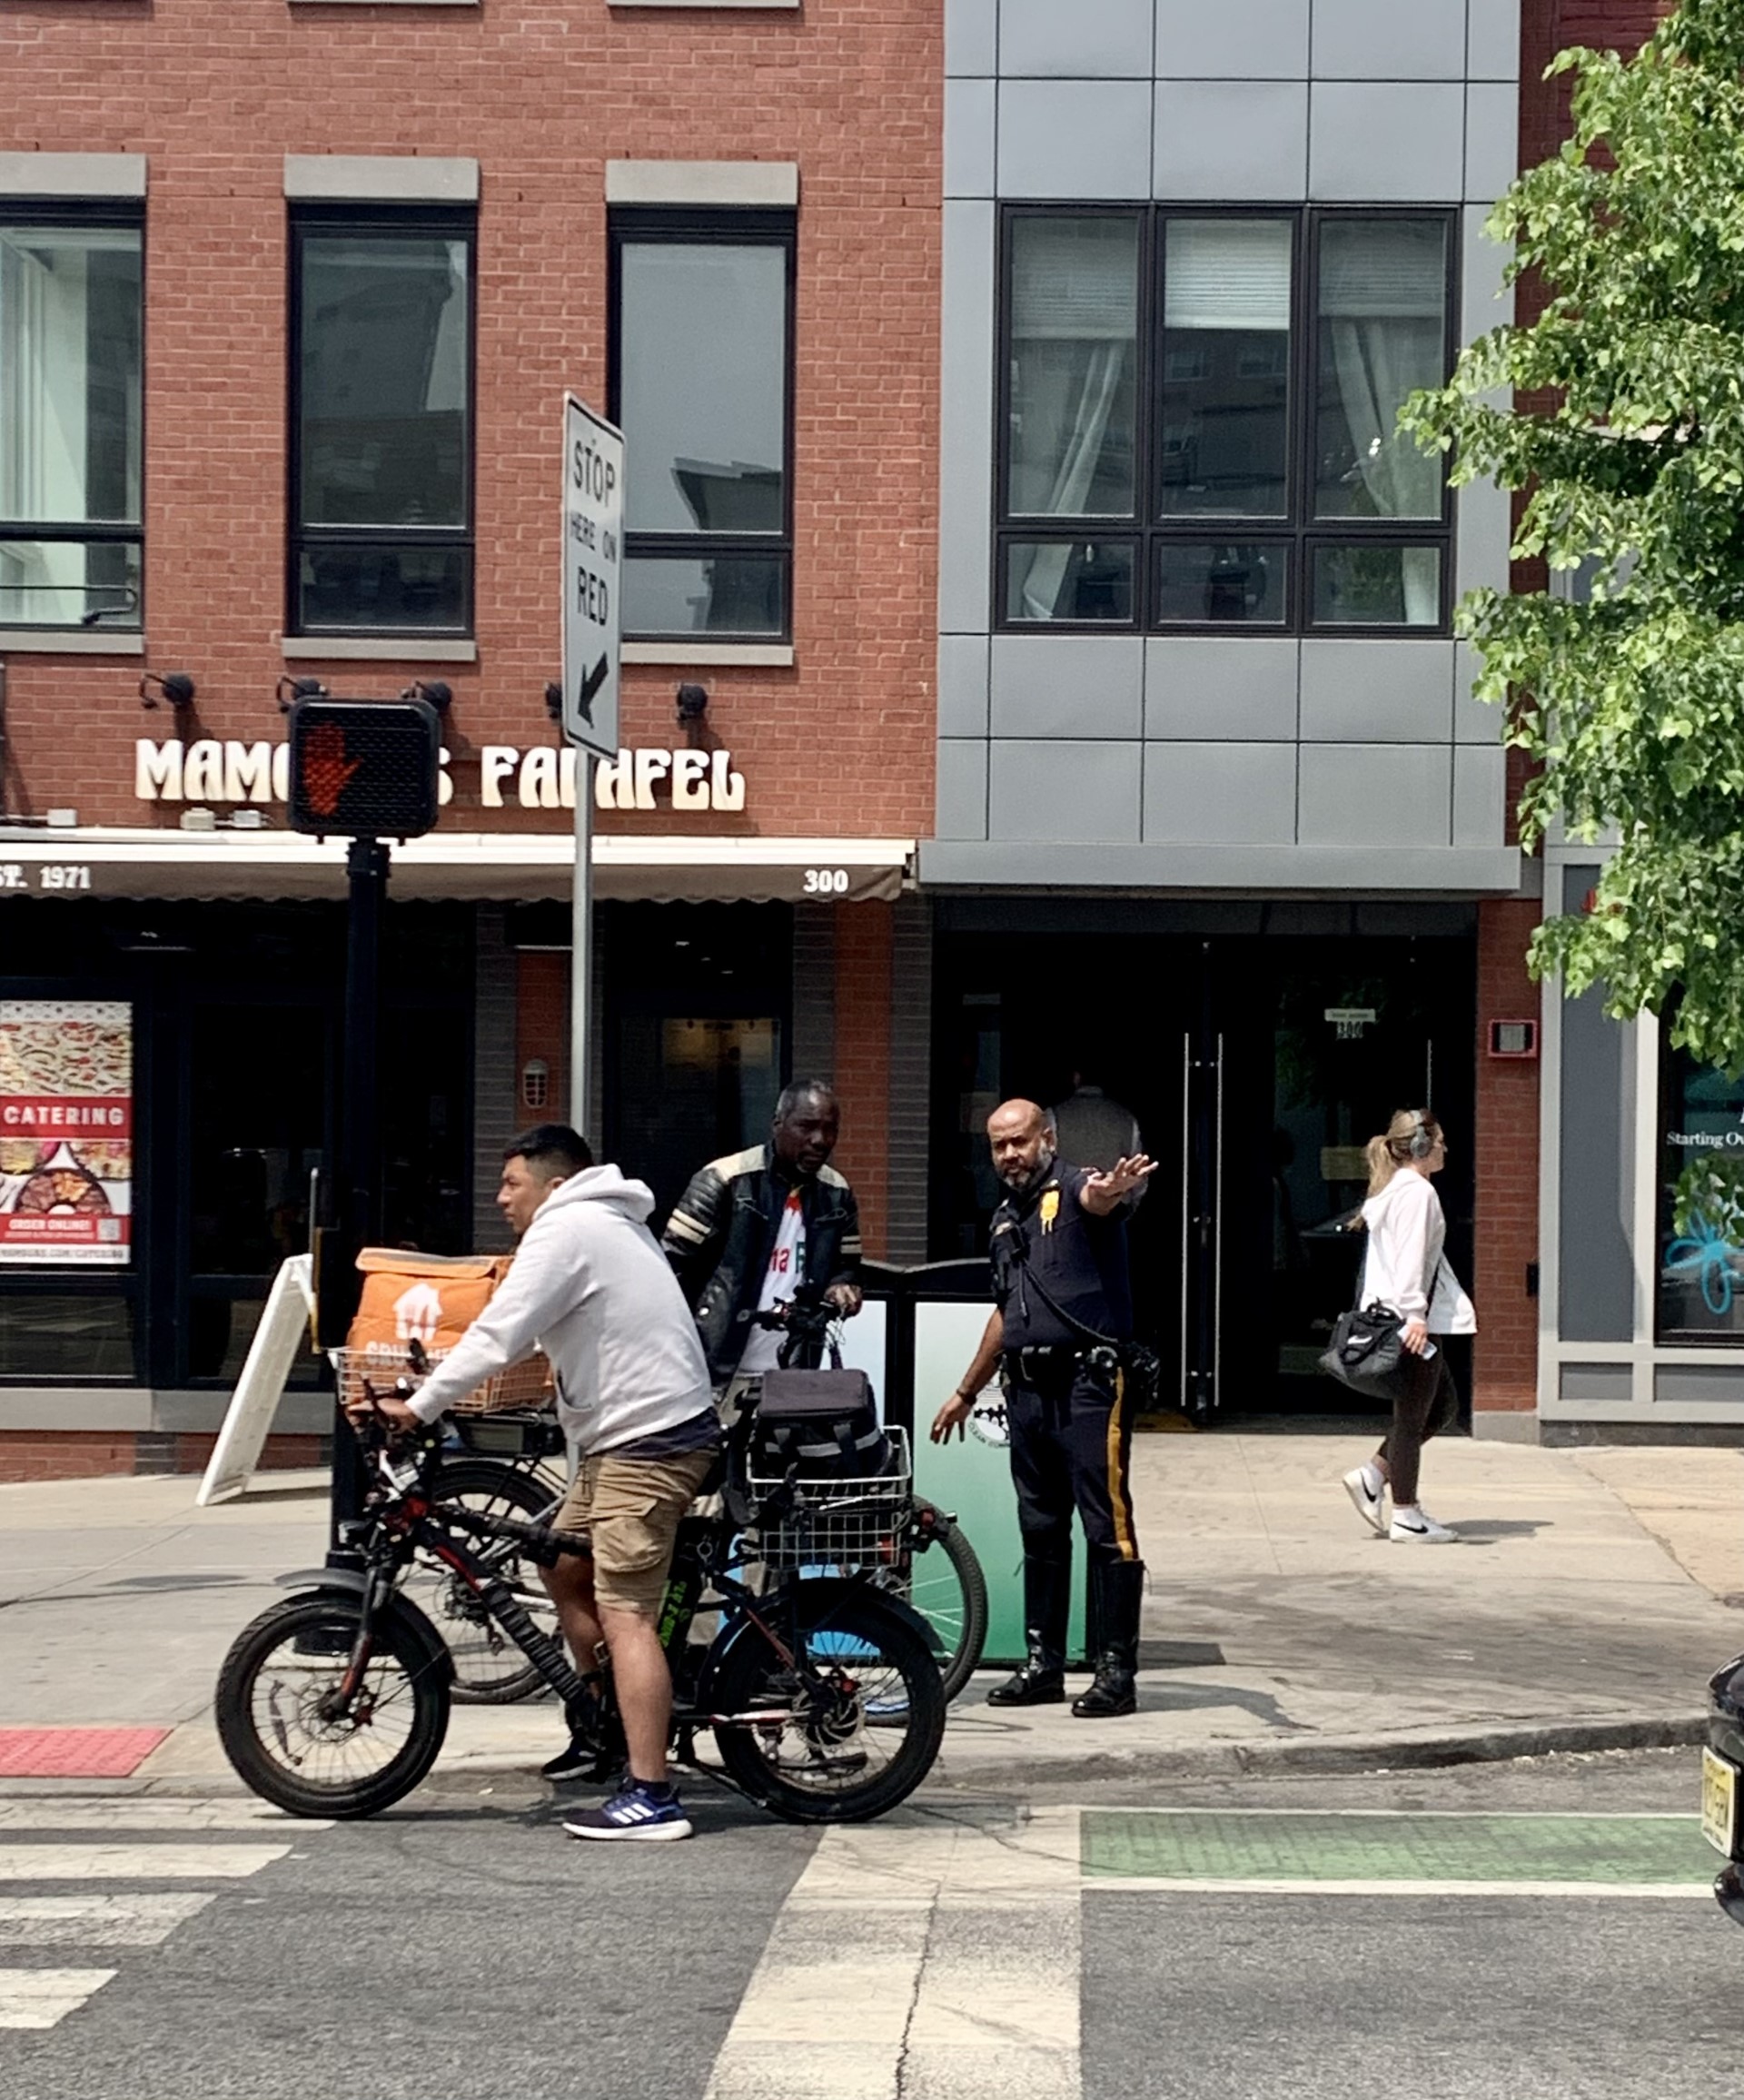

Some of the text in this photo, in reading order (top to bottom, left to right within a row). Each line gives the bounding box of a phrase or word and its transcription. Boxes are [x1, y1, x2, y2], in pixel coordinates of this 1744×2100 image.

[573, 441, 616, 508] STOP
[570, 514, 618, 564] HERE ON
[577, 565, 609, 626] RED
[40, 865, 92, 889] 1971
[803, 868, 849, 893] 300
[4, 1105, 124, 1125] CATERING
[1666, 1130, 1724, 1150] Starting
